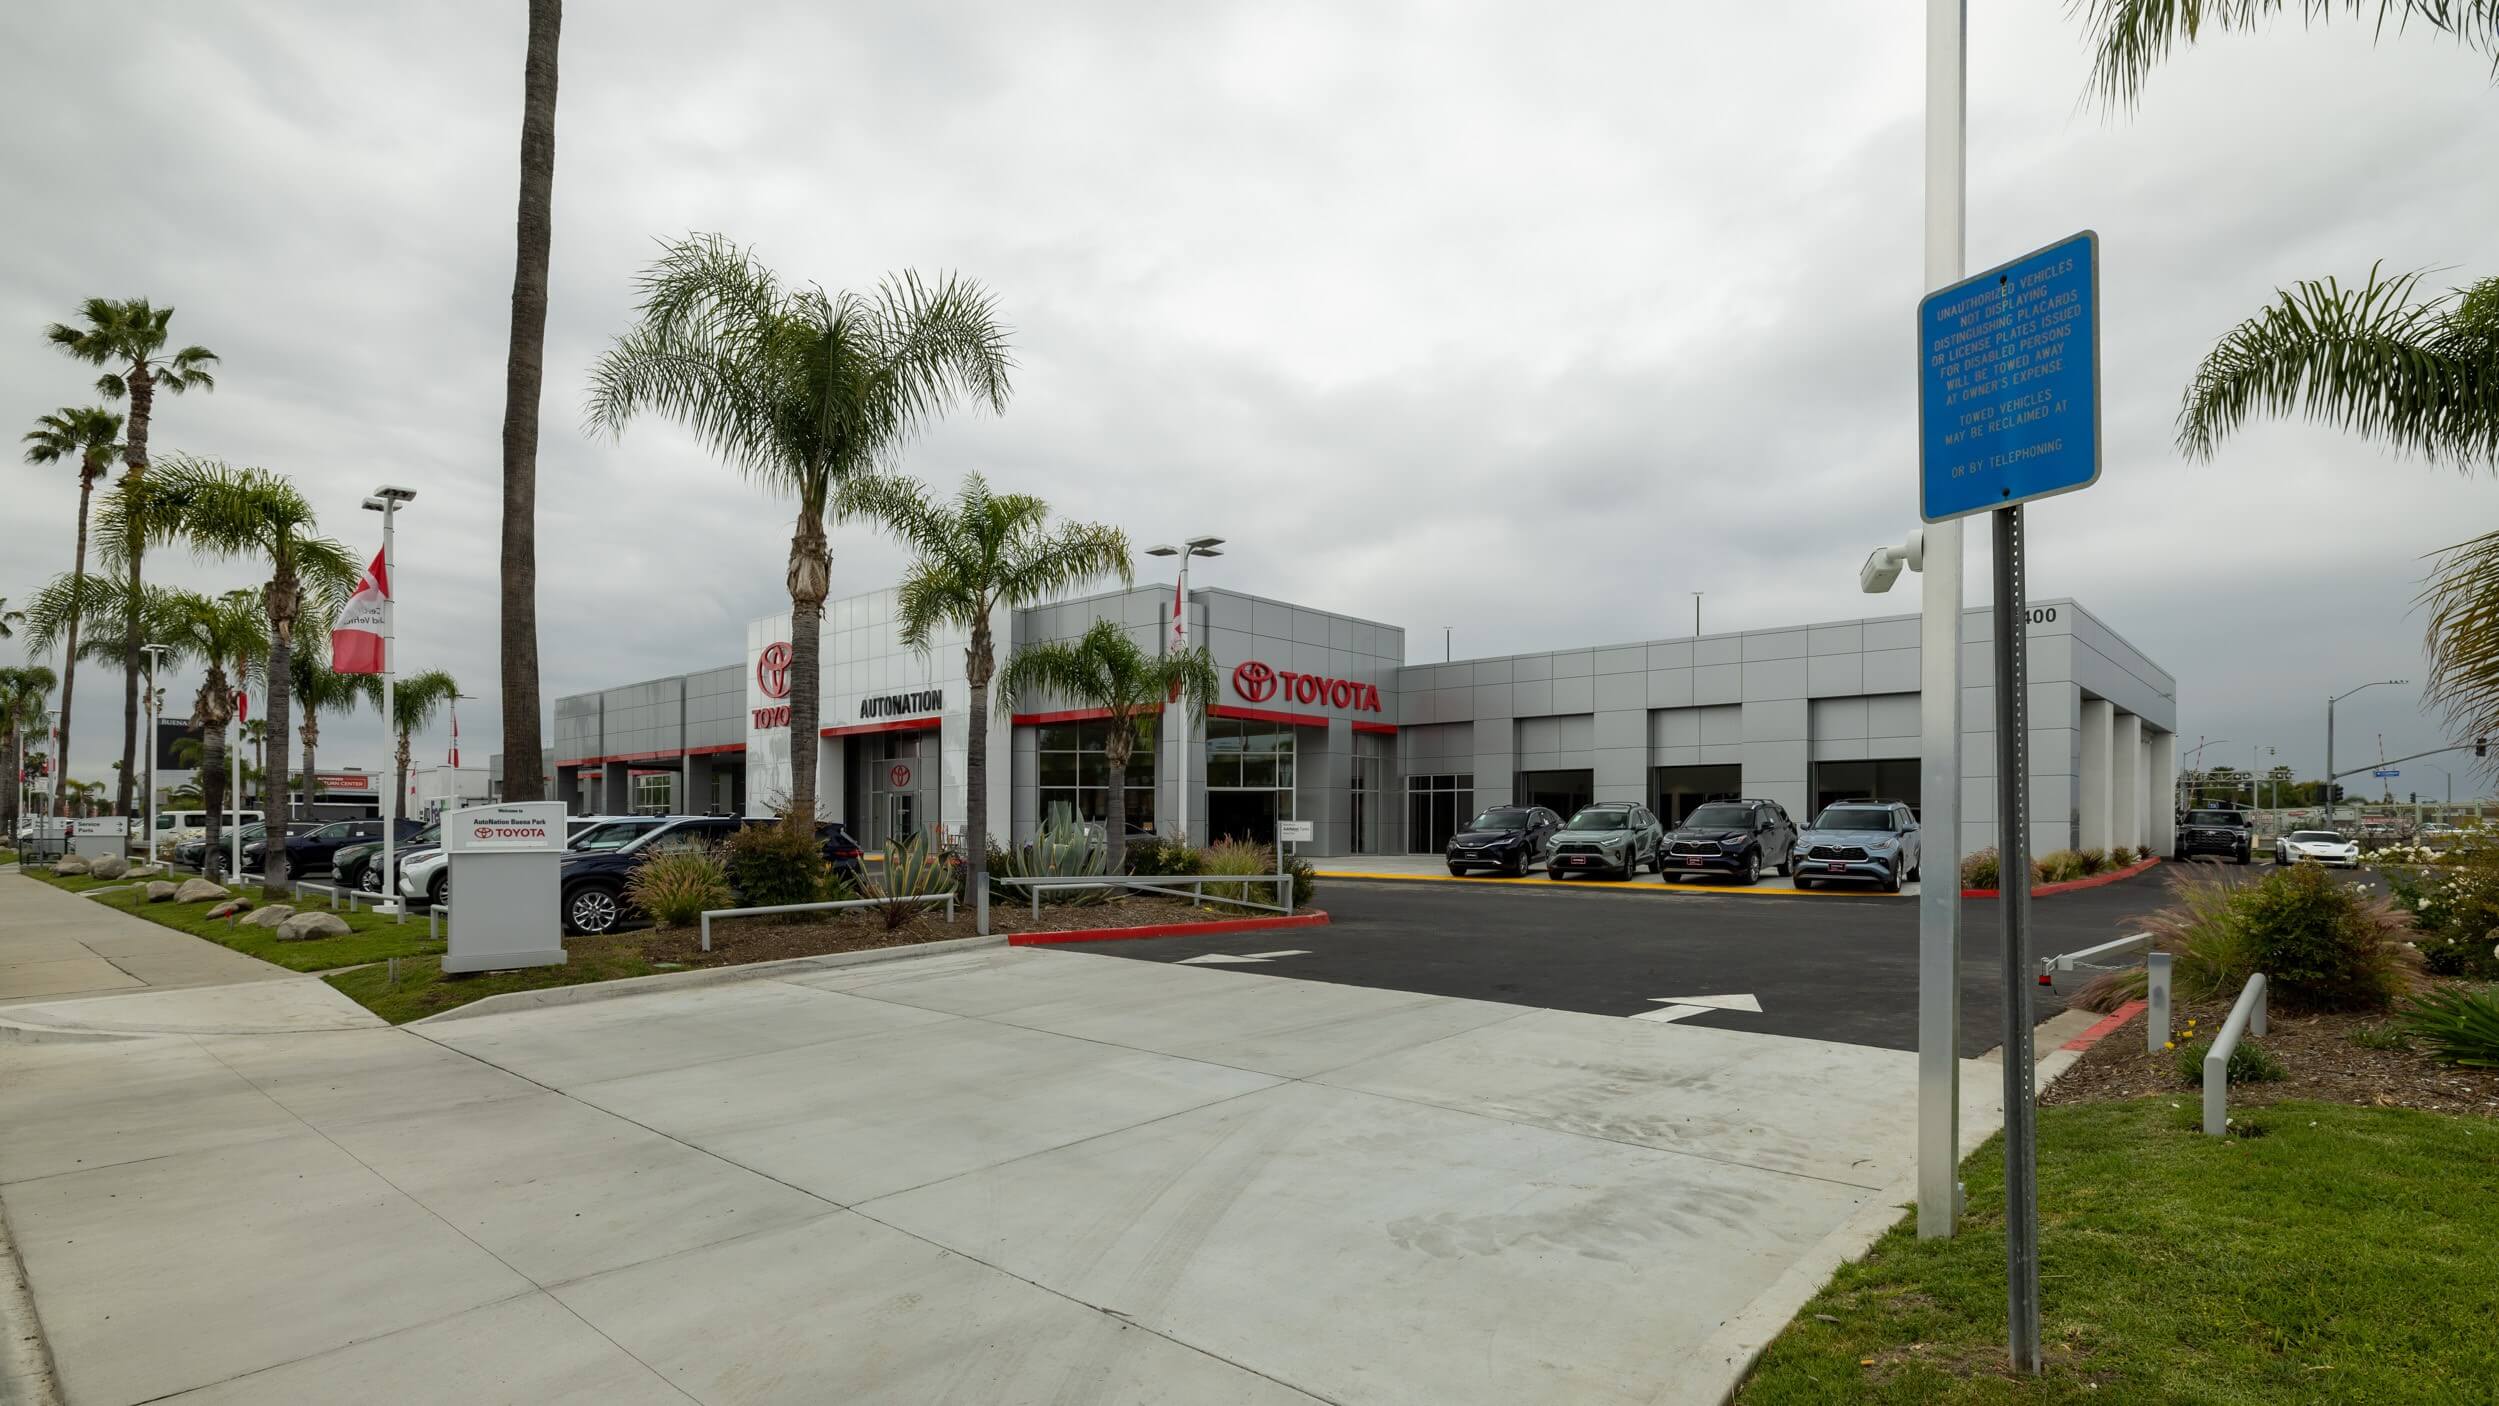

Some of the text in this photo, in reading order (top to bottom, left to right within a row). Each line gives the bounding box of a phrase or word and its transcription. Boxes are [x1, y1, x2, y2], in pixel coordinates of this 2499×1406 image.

[1937, 259, 2073, 321] UNAUTHORIZED VEHICLES
[1960, 285, 2048, 327] NOT DISPLAYING
[1931, 304, 2081, 367] OR LICENSE PLATES ISSUED
[1934, 290, 2078, 352] DISTINGUISHING PLACARDS
[1940, 324, 2072, 378] FOR DISABLED PERSONS
[1946, 342, 2065, 391] WILL BE TOWED AWAY
[1946, 394, 1957, 406] AT
[2013, 359, 2063, 385] EXPENSE
[1944, 400, 2068, 446] MAY BE RECLAIMED AT
[1960, 389, 2053, 426] TOWED VEHICLES
[1951, 438, 2063, 478] OR BY TELEPHONING
[860, 690, 943, 719] AUTONATION
[1279, 671, 1381, 712] TOYOTA
[752, 705, 792, 729] TOYO
[495, 828, 546, 838] TOYOTA
